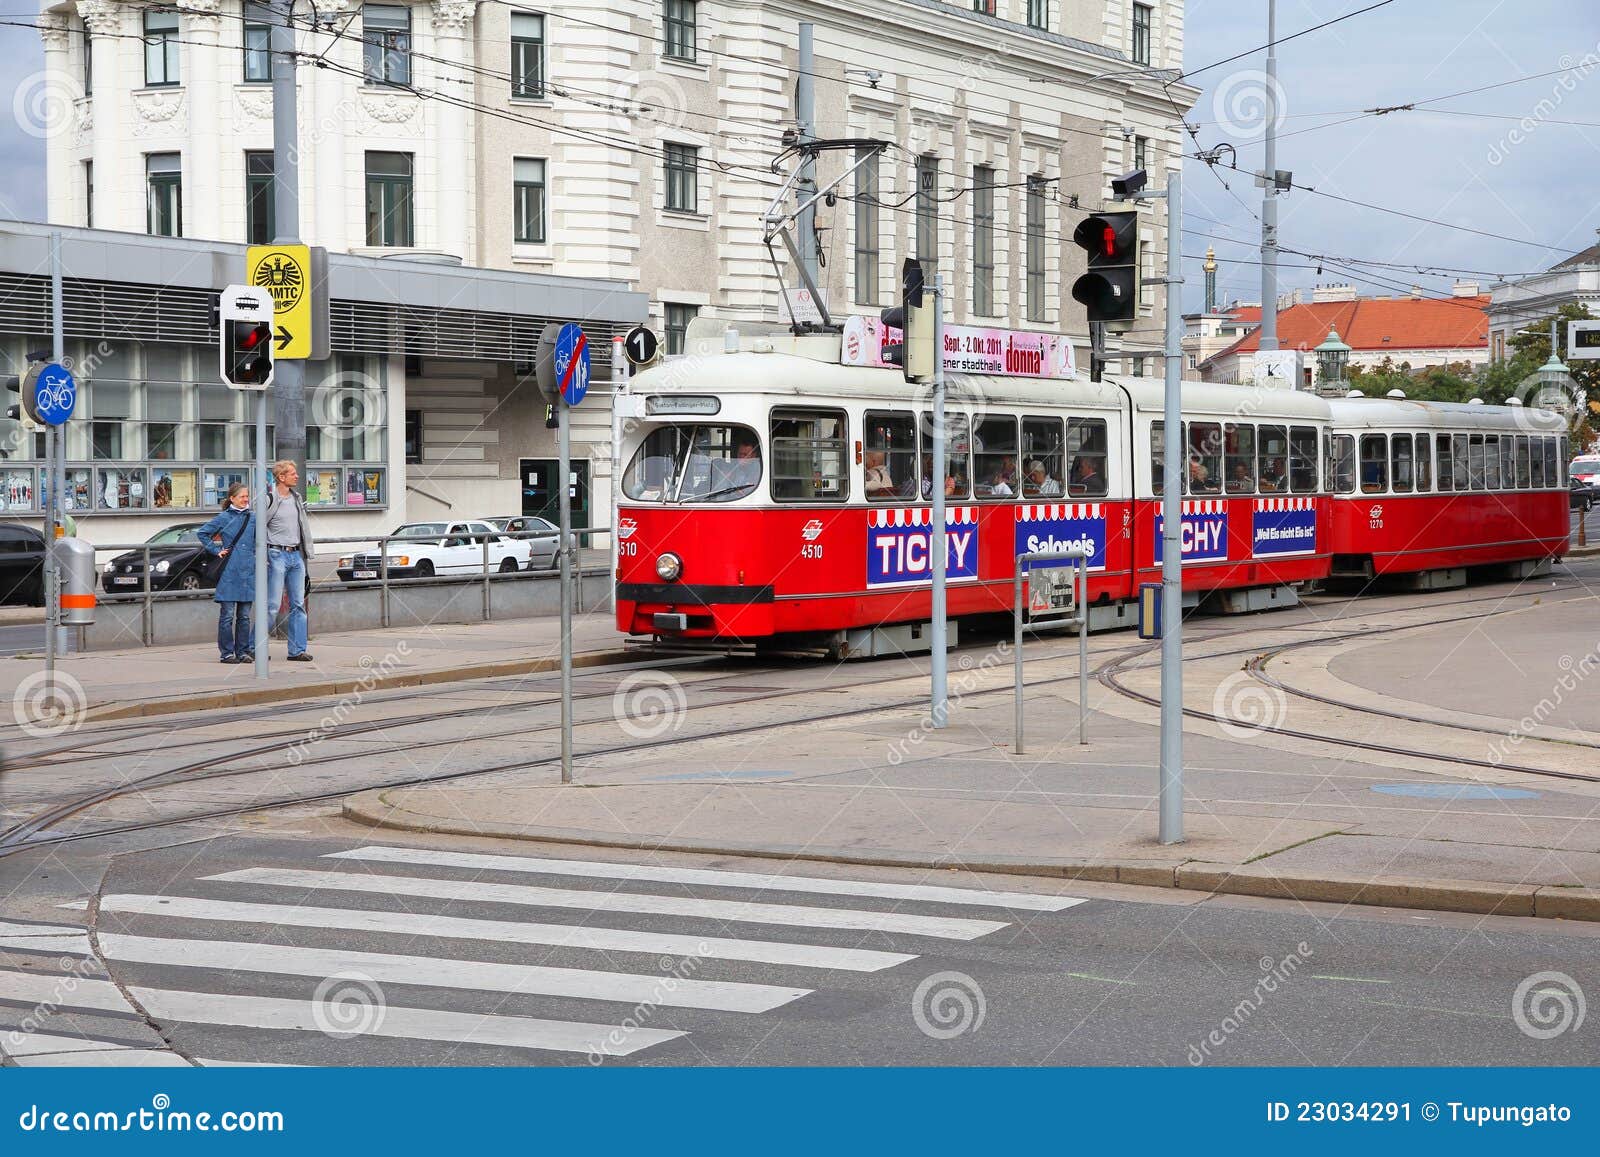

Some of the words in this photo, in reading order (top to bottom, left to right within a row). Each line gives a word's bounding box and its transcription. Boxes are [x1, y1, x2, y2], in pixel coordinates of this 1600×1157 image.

[633, 333, 645, 360] 1
[944, 334, 961, 353] Sept.
[987, 338, 1002, 356] 2011
[1006, 335, 1040, 374] donna
[943, 359, 960, 369] ener
[962, 358, 1002, 372] stadthalle
[1369, 519, 1384, 529] 1270
[1160, 520, 1223, 553] CHY
[619, 542, 637, 556] 510
[801, 544, 823, 559] 4510
